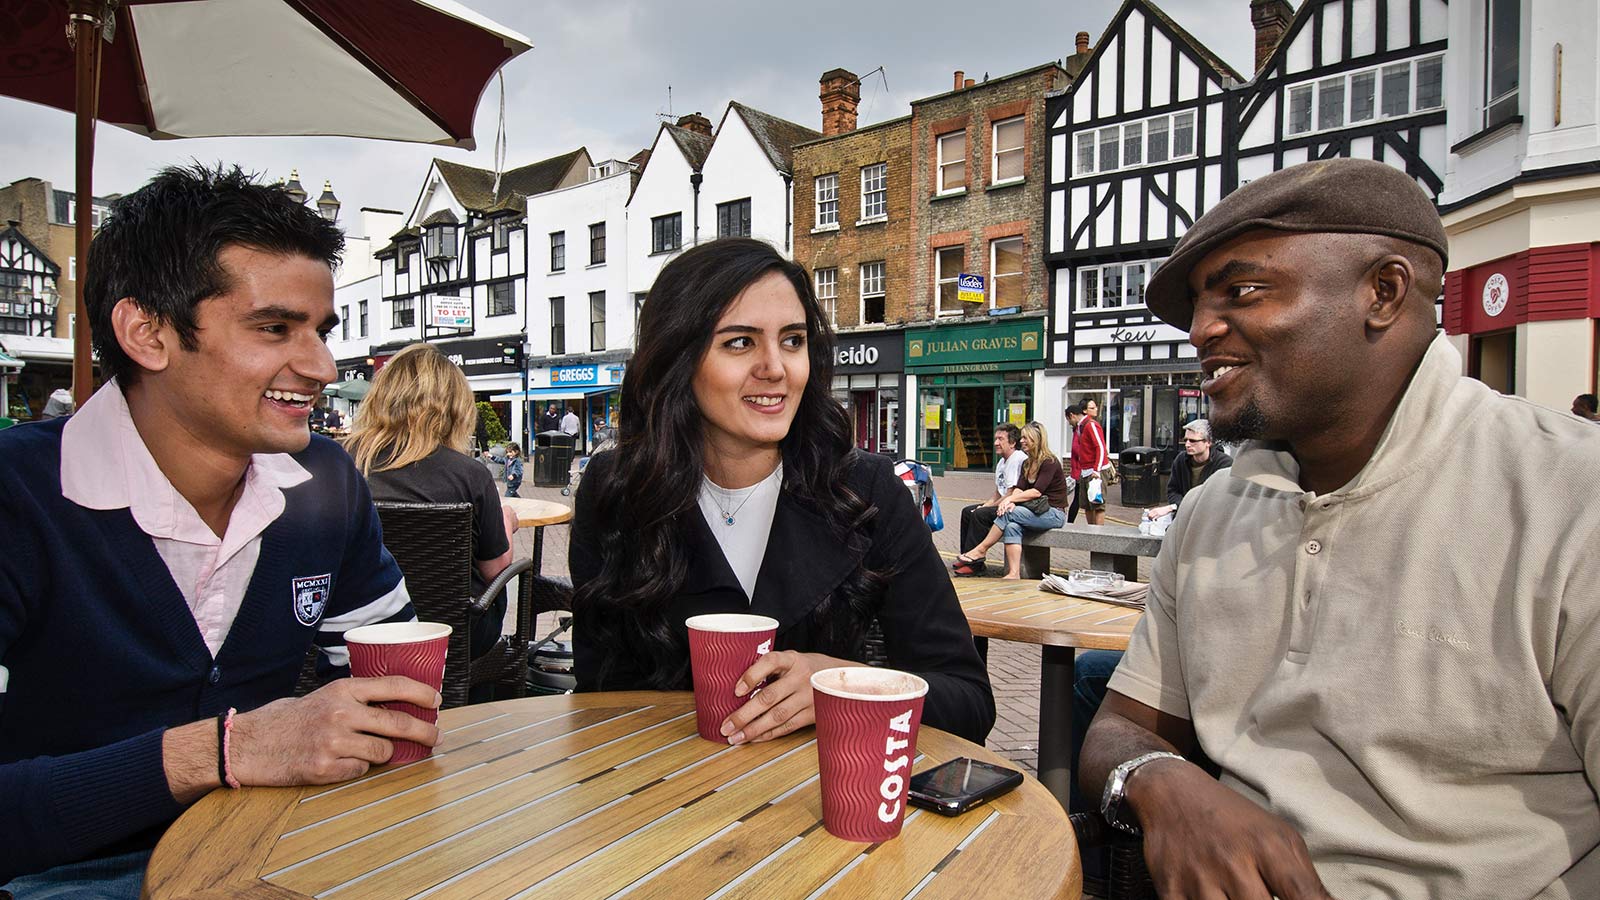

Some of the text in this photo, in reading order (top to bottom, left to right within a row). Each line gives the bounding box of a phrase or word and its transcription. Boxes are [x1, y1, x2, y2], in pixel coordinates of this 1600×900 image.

[960, 277, 983, 288] Leaders
[1487, 277, 1503, 289] COSTA
[1110, 327, 1156, 343] Kew
[926, 337, 1018, 356] JULIAN GRAVES
[943, 363, 999, 373] JULIAN GRAVES
[560, 368, 593, 382] GREGGS
[297, 578, 328, 588] MCMXXI
[878, 709, 913, 824] COSTA
